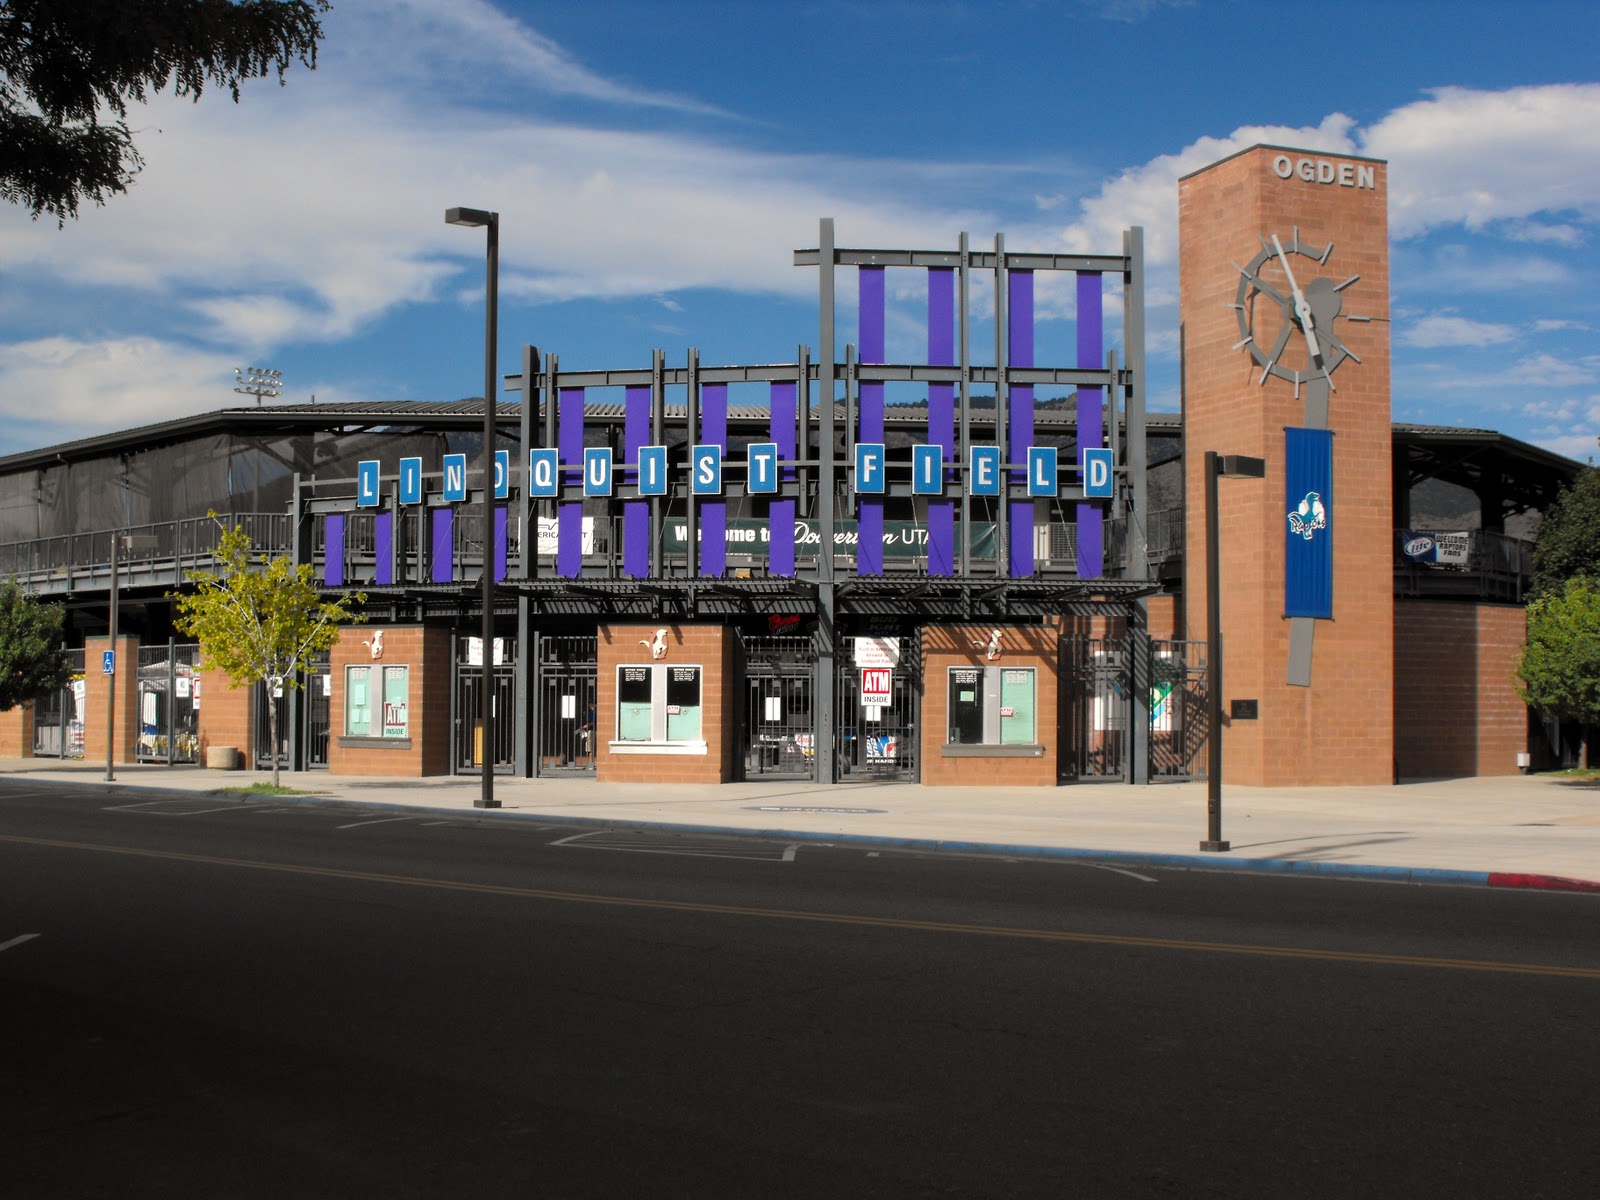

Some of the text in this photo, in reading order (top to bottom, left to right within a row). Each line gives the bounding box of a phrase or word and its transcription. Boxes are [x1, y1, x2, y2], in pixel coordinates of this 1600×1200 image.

[1273, 155, 1375, 190] OGDEN
[864, 455, 1108, 487] FIELD
[761, 527, 770, 542] t
[902, 529, 928, 545] UT
[1436, 535, 1468, 545] WELCOME
[1439, 543, 1466, 551] RAPTORS
[863, 671, 890, 692] ATM
